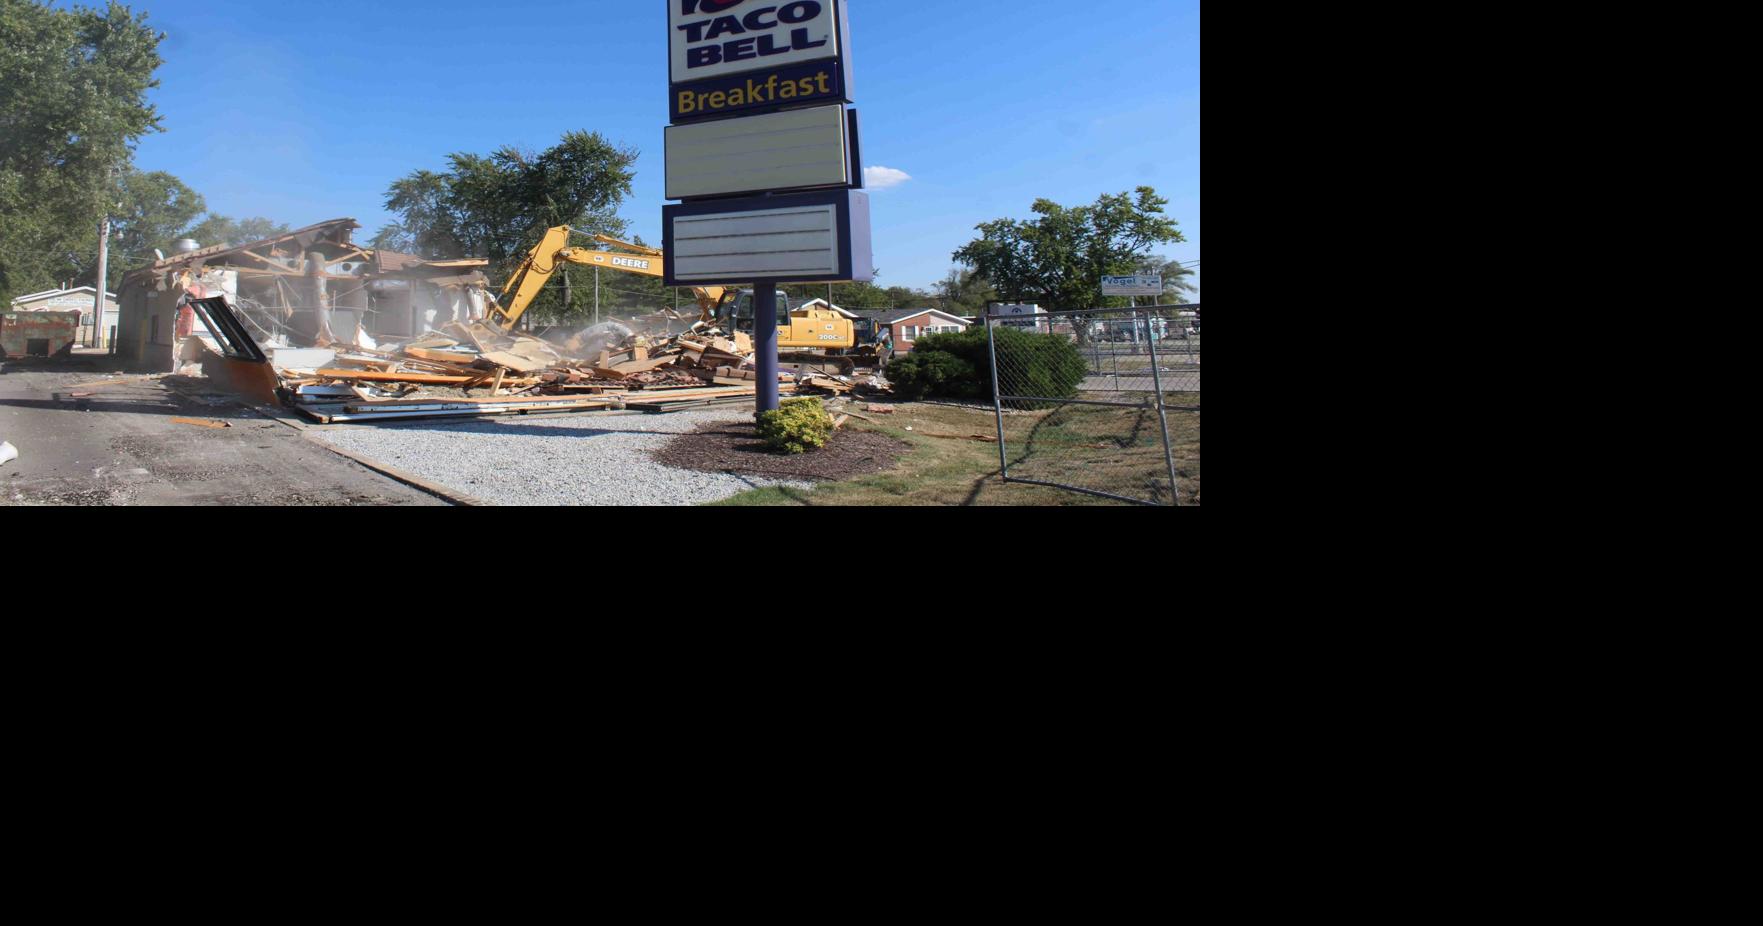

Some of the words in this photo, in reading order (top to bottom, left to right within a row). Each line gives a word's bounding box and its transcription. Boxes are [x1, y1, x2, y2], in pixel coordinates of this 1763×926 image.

[677, 0, 822, 43] TACO
[687, 28, 827, 69] BELL
[678, 71, 830, 113] Breakfast
[612, 256, 649, 269] DEERE
[1106, 278, 1136, 286] Vogel
